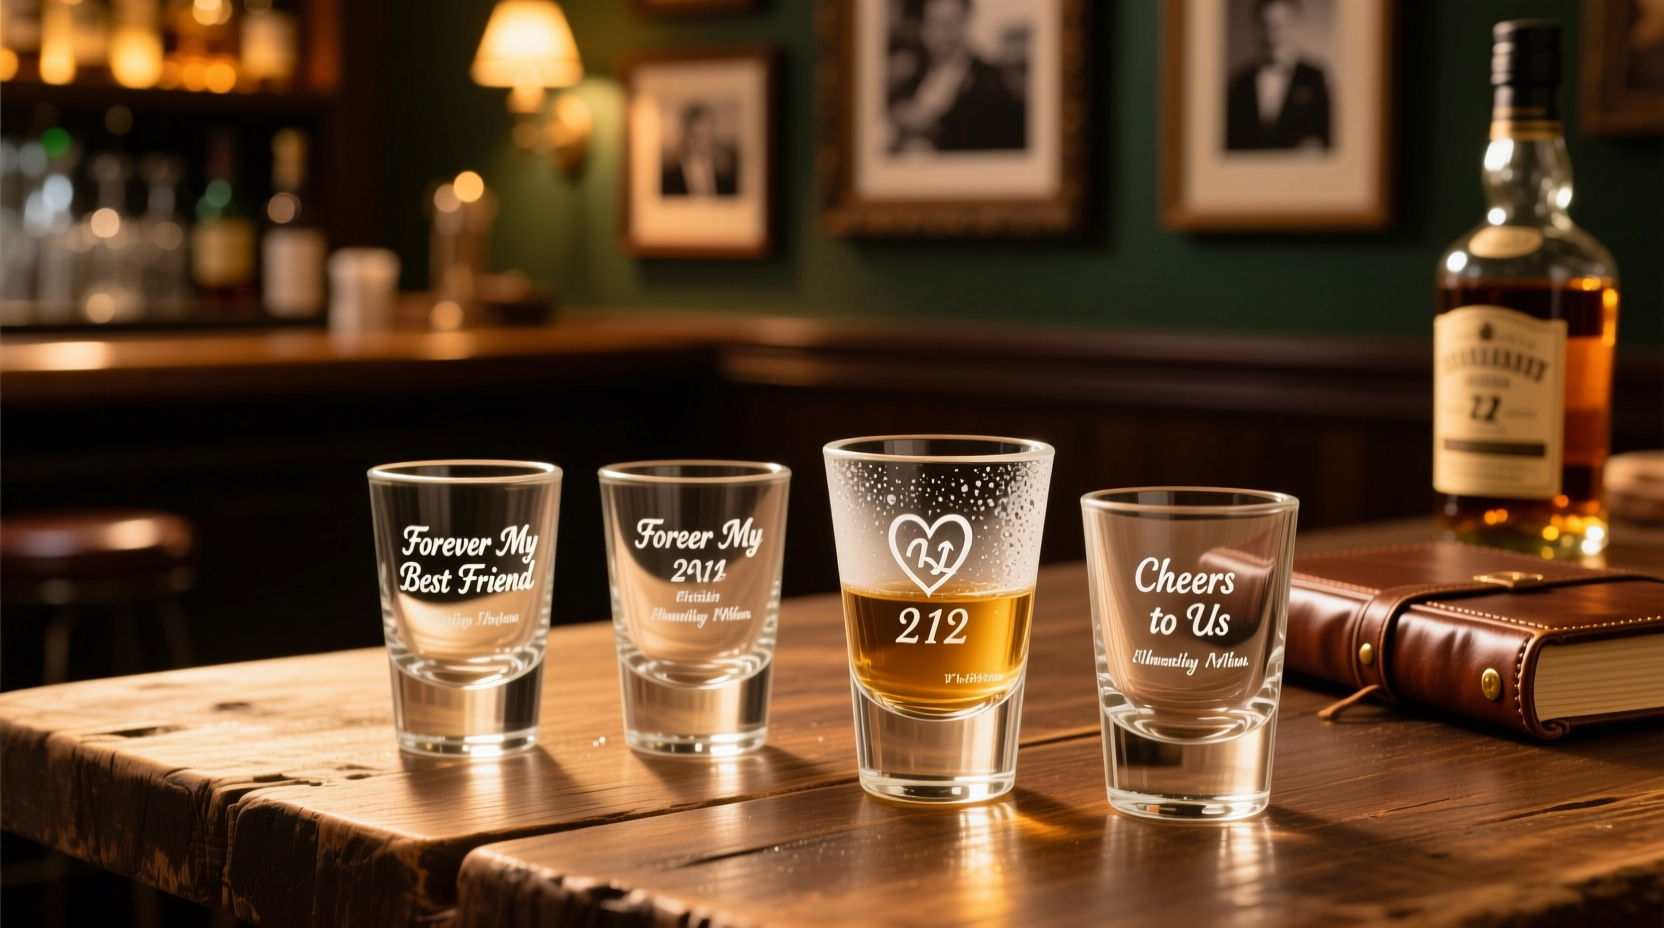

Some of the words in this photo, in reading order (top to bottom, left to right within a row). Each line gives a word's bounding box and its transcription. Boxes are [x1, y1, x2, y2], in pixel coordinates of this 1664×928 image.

[402, 525, 492, 557] Forever
[495, 524, 538, 564] My
[634, 518, 714, 550] Foreer
[718, 517, 763, 558] My
[399, 561, 452, 594] Best
[457, 559, 536, 595] Friend
[1134, 556, 1235, 595] Cheers
[895, 607, 969, 644] 212
[1149, 606, 1177, 636] to
[1186, 602, 1231, 637] Us
